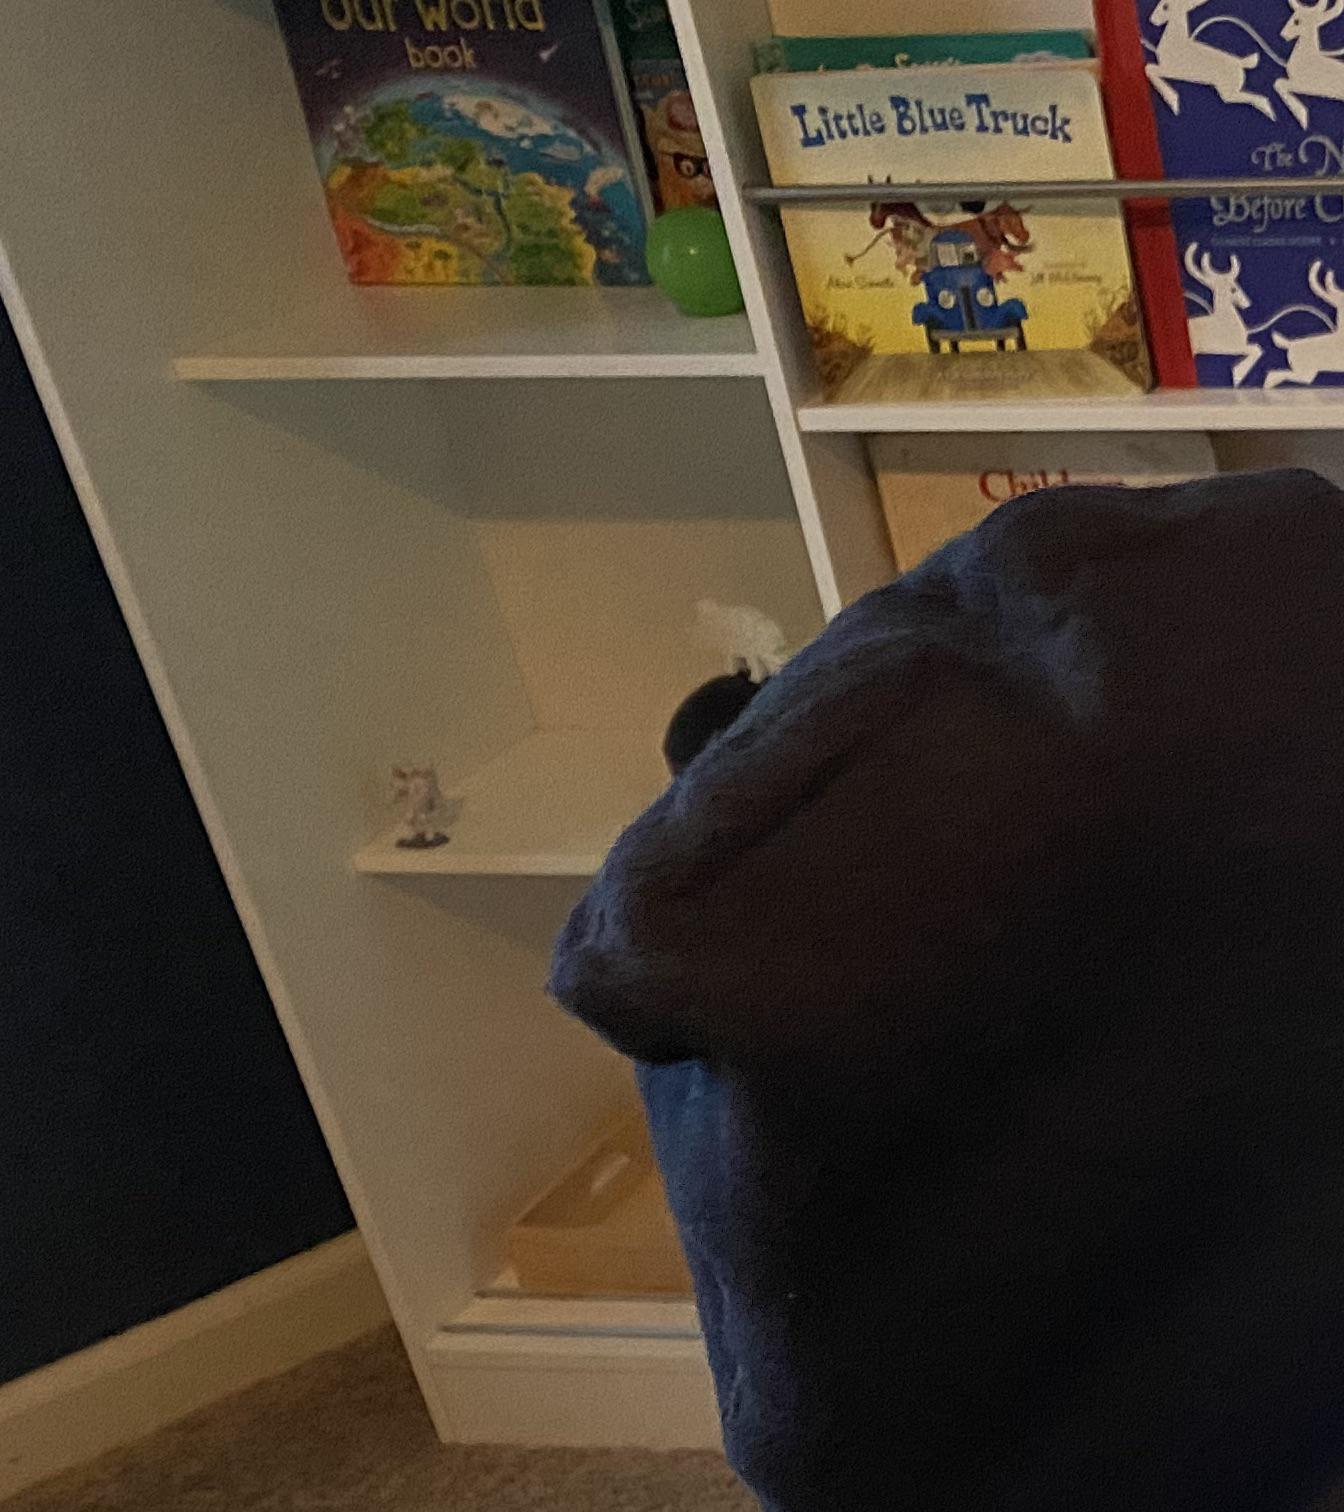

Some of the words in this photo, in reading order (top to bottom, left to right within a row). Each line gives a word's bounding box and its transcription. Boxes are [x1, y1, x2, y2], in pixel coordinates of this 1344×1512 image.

[404, 36, 477, 69] book
[790, 103, 886, 148] Little
[888, 95, 966, 137] Blue
[964, 93, 1072, 144] Truck
[1251, 142, 1294, 171] The
[1209, 193, 1307, 233] Before
